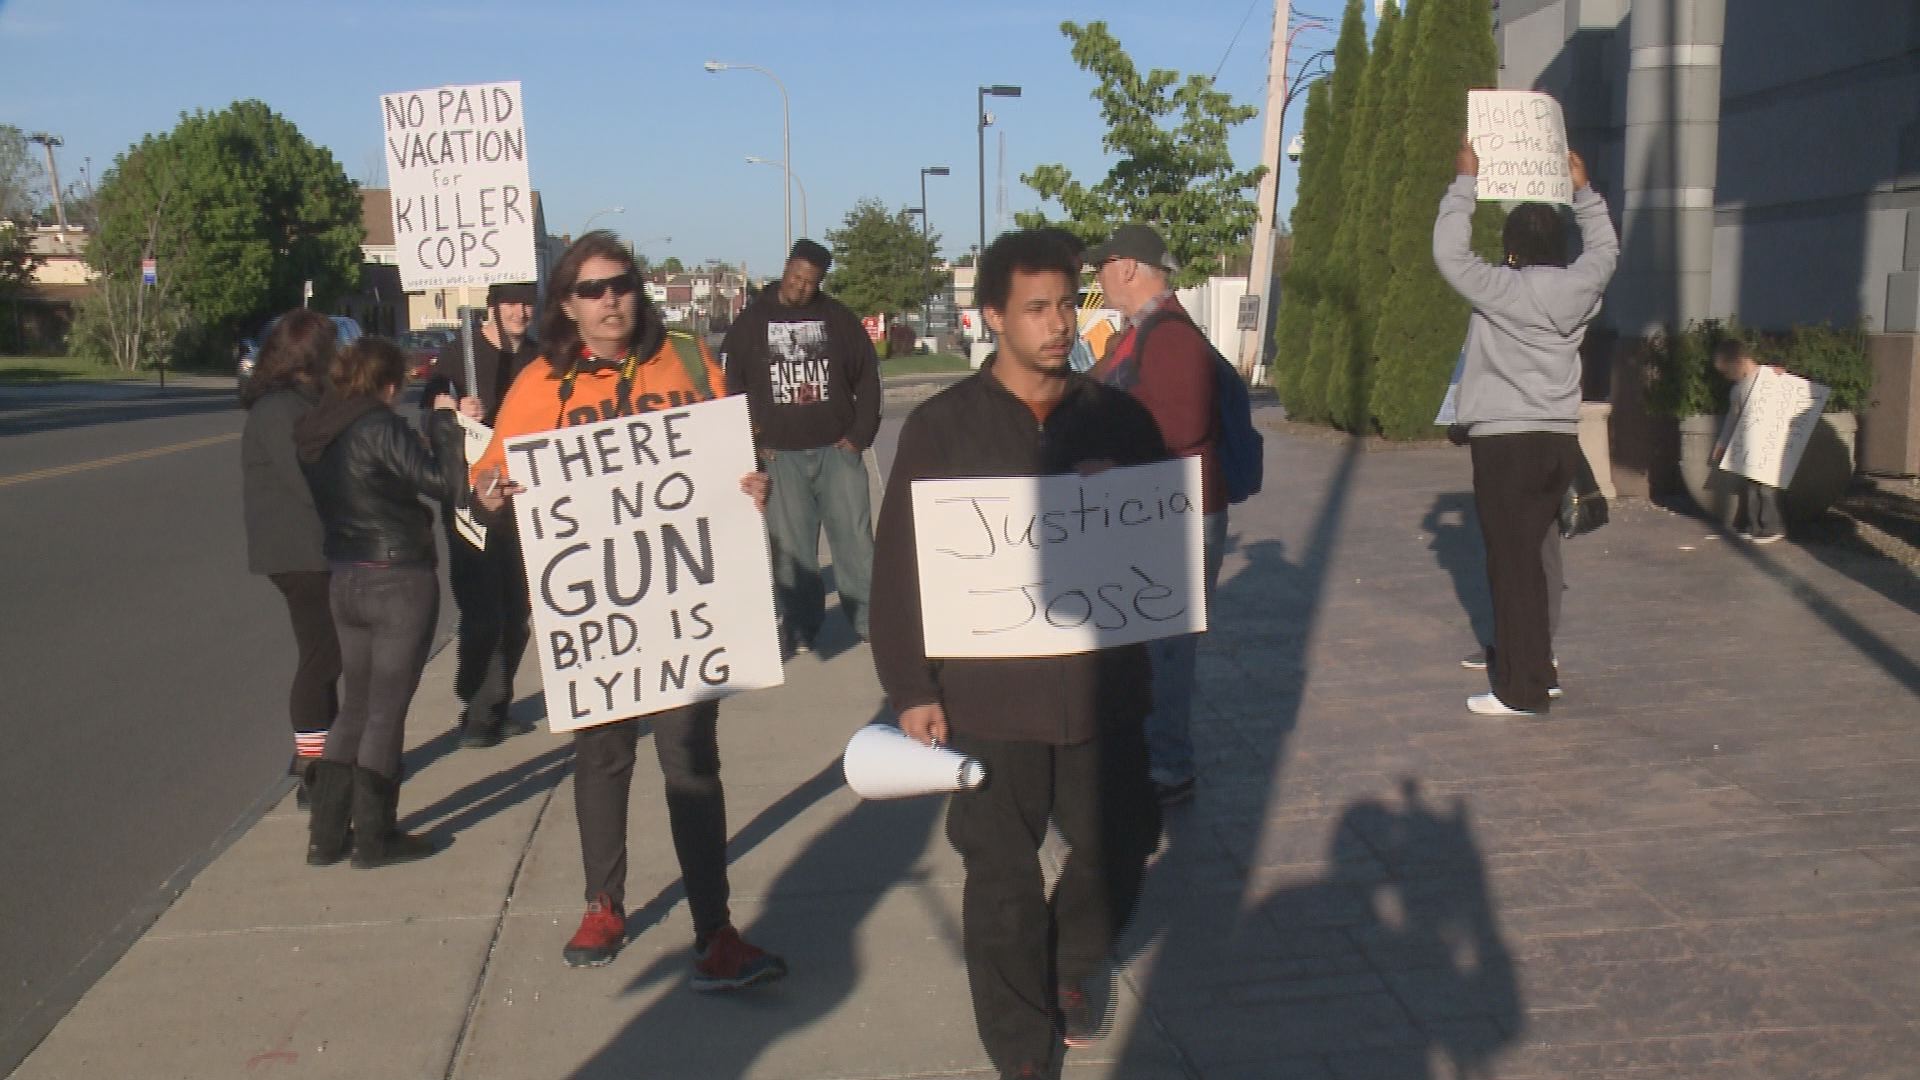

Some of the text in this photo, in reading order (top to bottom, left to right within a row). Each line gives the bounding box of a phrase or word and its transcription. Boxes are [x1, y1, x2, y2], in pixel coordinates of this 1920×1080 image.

[384, 87, 513, 130] NO PAID
[1475, 96, 1529, 131] Hold
[388, 128, 523, 169] VACATION
[1508, 130, 1543, 152] the
[396, 185, 525, 233] KILLER
[1526, 180, 1546, 196] do
[417, 230, 501, 269] COPS
[446, 274, 474, 285] WORLD
[484, 272, 528, 284] BUFFALO
[769, 359, 829, 386] ENEMY
[508, 412, 692, 487] THERE
[531, 471, 695, 541] IS NO
[935, 486, 1195, 559] Justicia
[540, 516, 715, 617] GUN
[550, 602, 714, 670] B.P.D. IS
[568, 646, 730, 719] LYING
